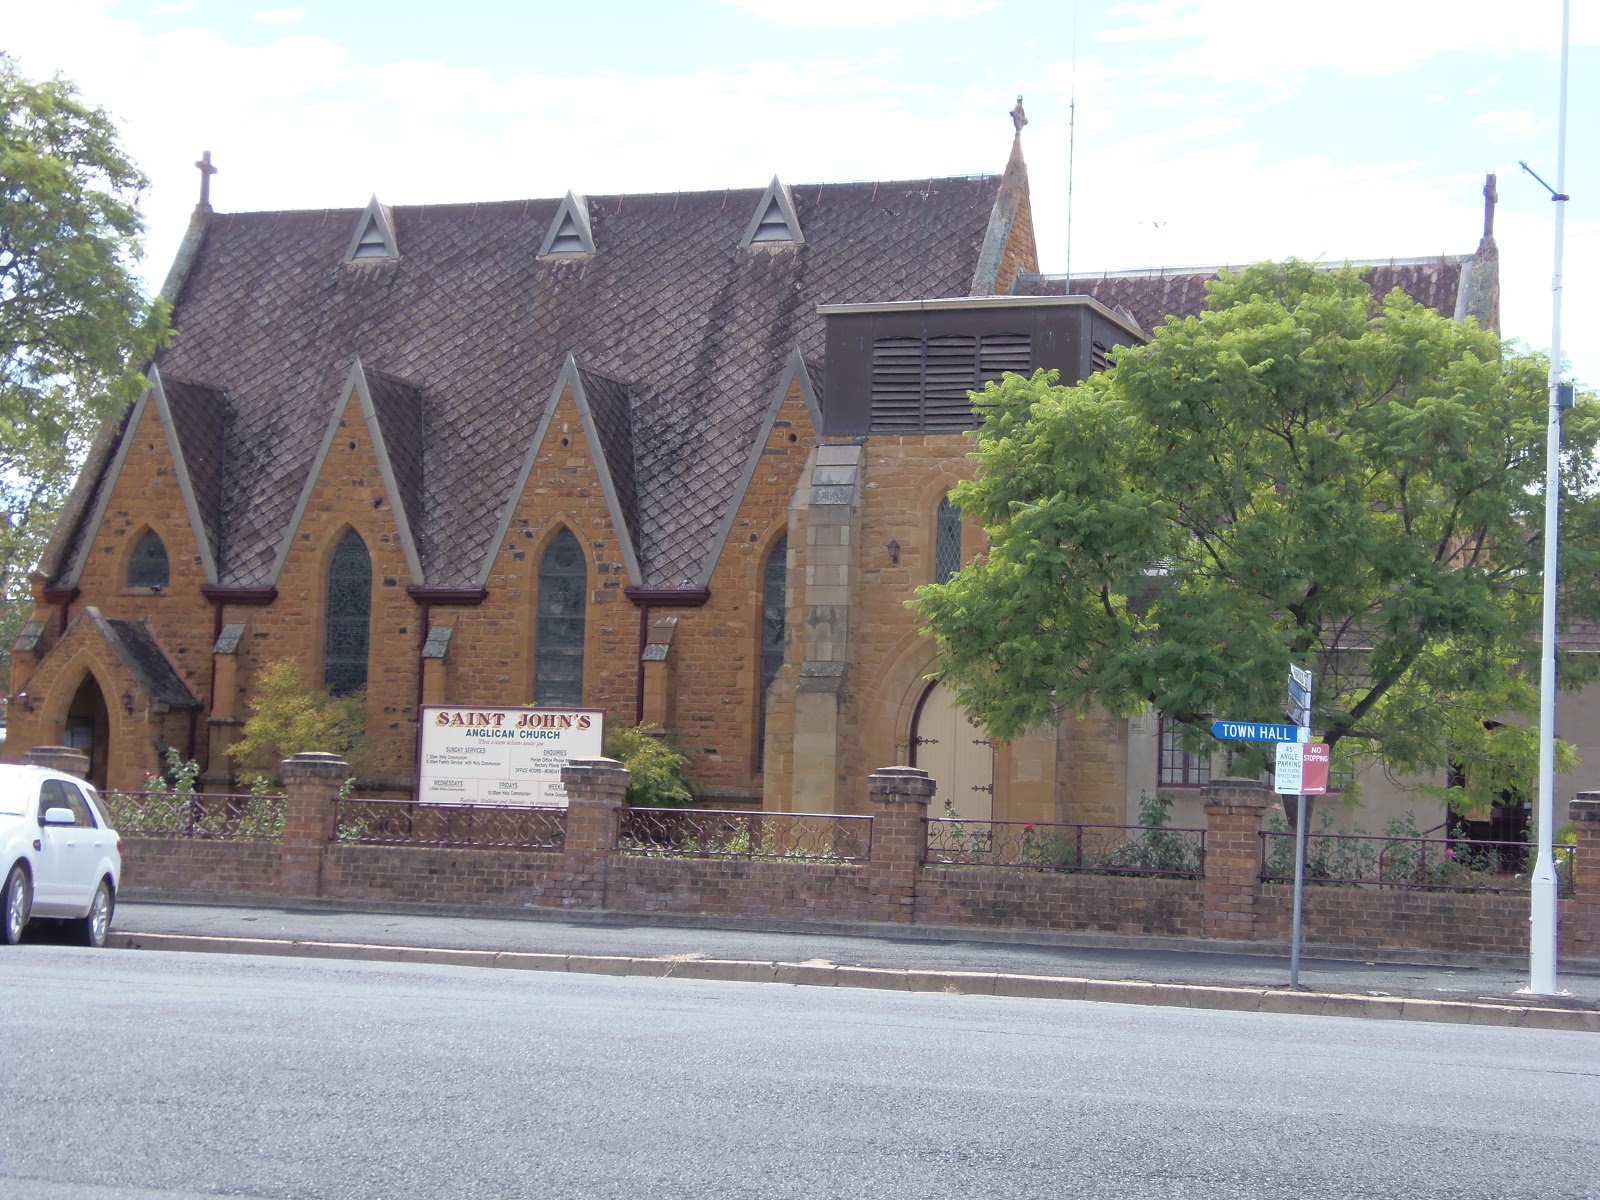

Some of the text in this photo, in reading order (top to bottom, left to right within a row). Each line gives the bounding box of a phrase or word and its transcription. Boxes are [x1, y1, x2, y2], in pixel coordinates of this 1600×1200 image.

[435, 711, 591, 731] SAINT JOHN'S
[465, 728, 560, 739] ANGLICAN CHURCH
[1222, 724, 1290, 740] TOWN HALL
